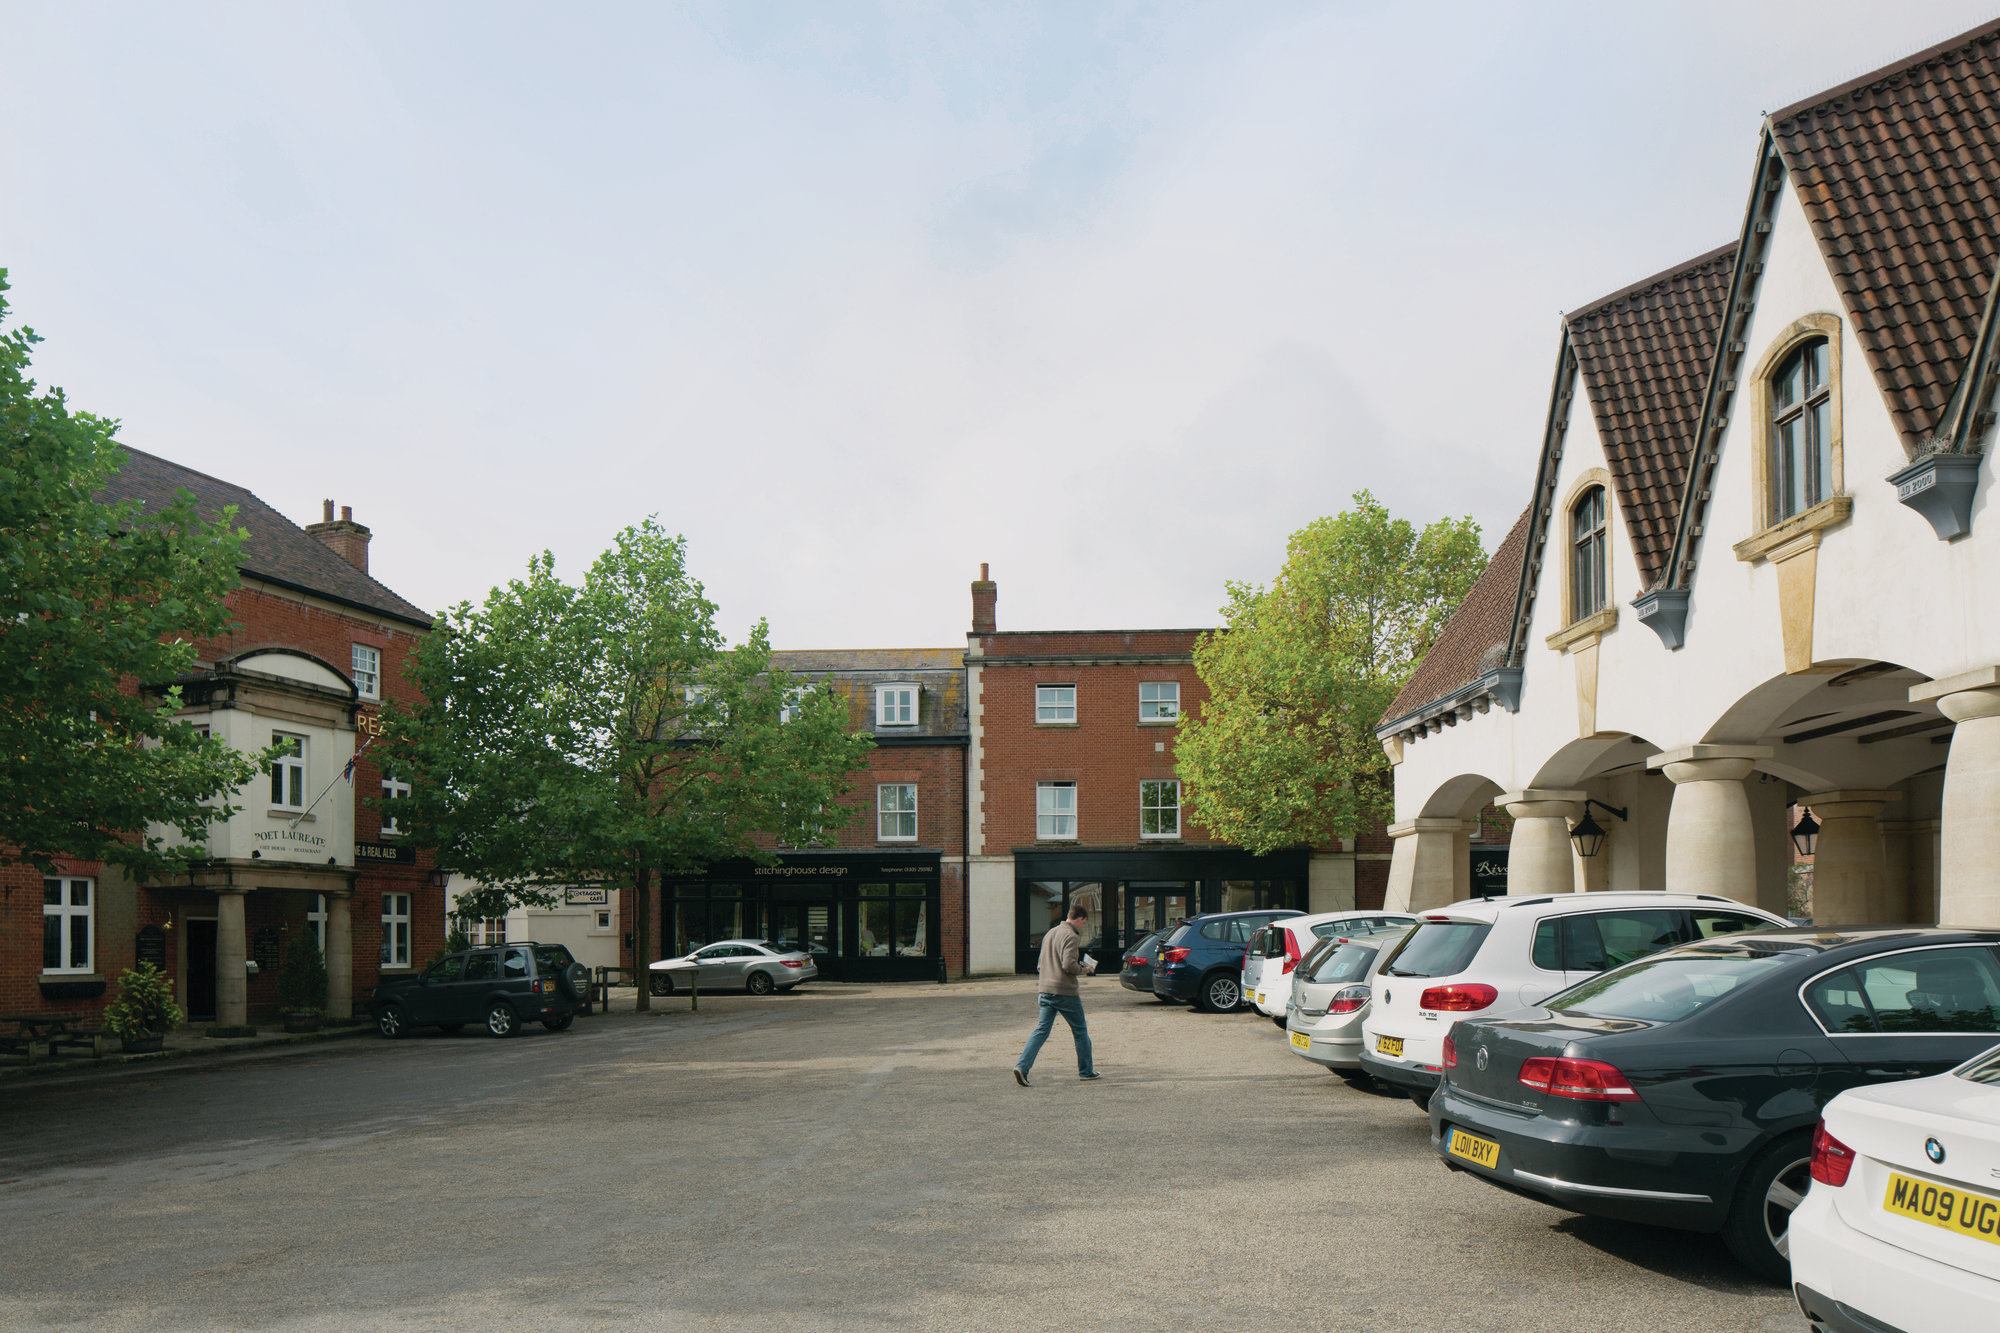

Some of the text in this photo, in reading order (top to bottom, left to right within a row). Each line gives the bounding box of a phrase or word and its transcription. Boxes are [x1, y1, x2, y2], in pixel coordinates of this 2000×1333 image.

[281, 830, 326, 847] LAUREATE
[367, 846, 381, 858] REAL
[382, 848, 397, 859] ALES
[754, 866, 848, 877] stitchinghouse design
[1455, 1134, 1493, 1162] LO11 BXY
[1892, 1179, 1954, 1221] MA09
